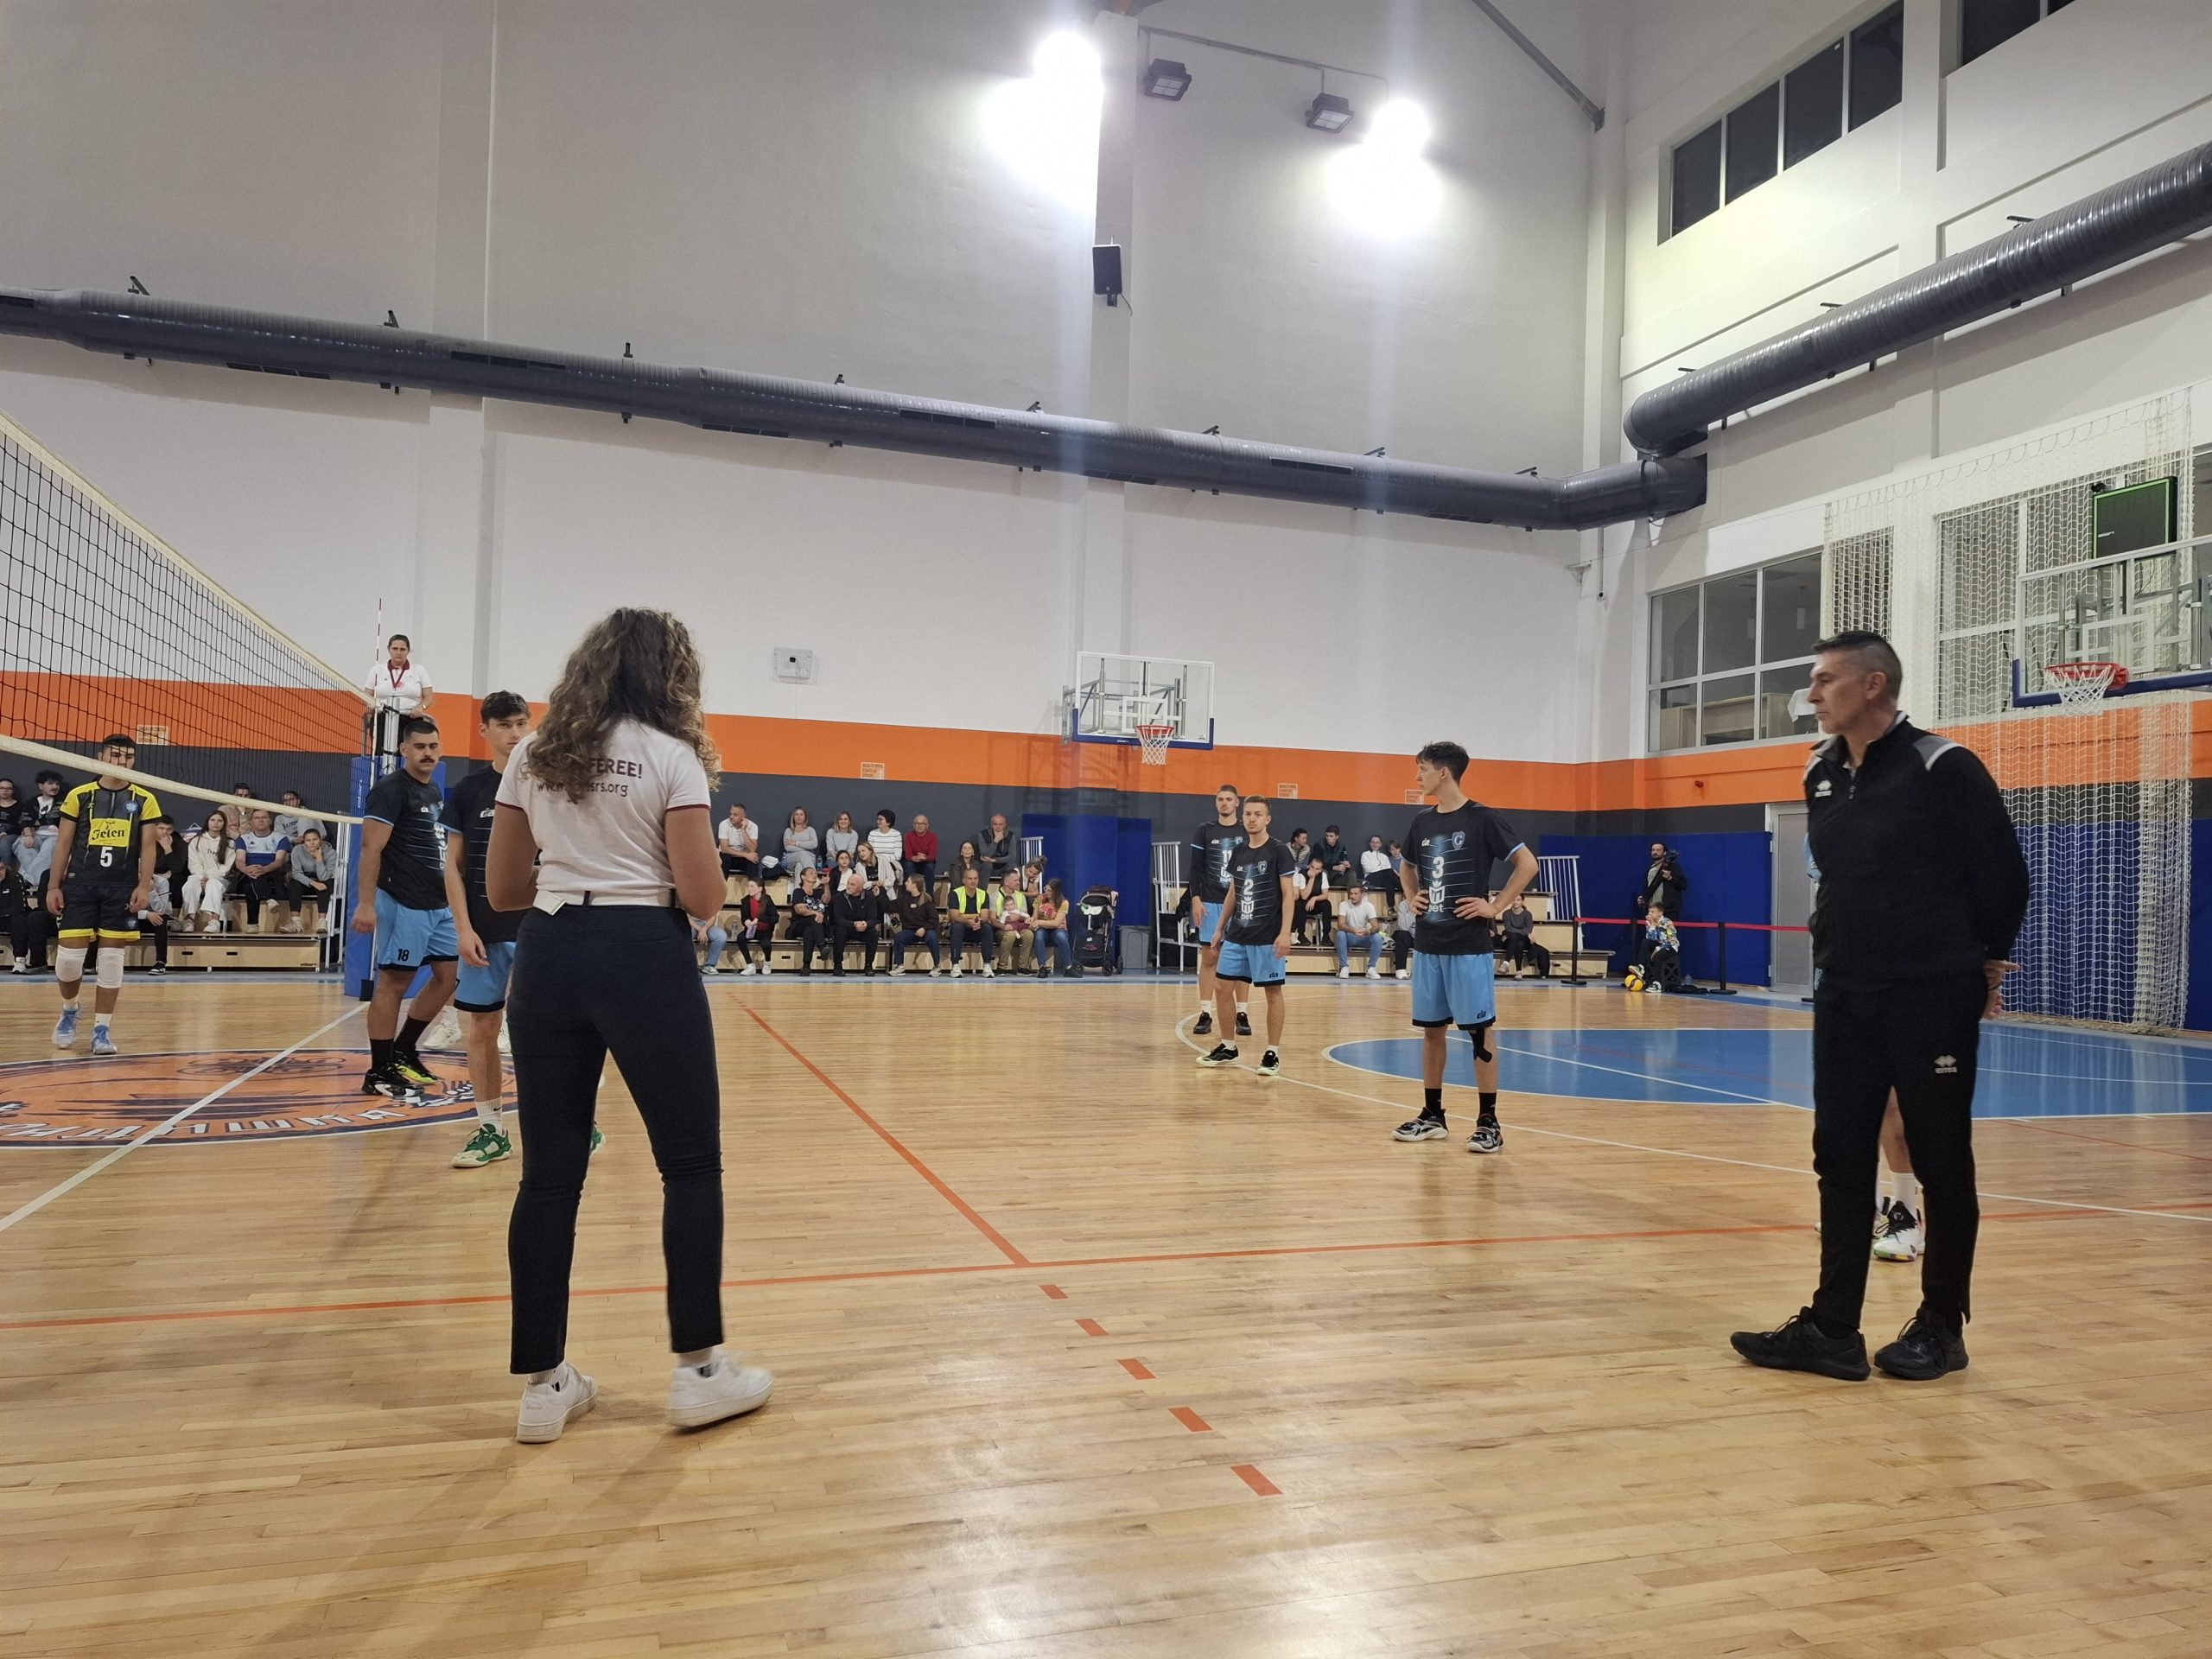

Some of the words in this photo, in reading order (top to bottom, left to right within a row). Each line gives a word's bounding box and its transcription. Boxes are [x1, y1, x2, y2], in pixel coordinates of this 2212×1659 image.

[588, 757, 643, 779] FEREE!
[92, 828, 125, 841] Jelen
[99, 846, 113, 868] 5
[1432, 856, 1445, 879] 3
[1243, 879, 1254, 896] 2
[397, 949, 410, 962] 18
[0, 1109, 406, 1139] РАДИШКА
